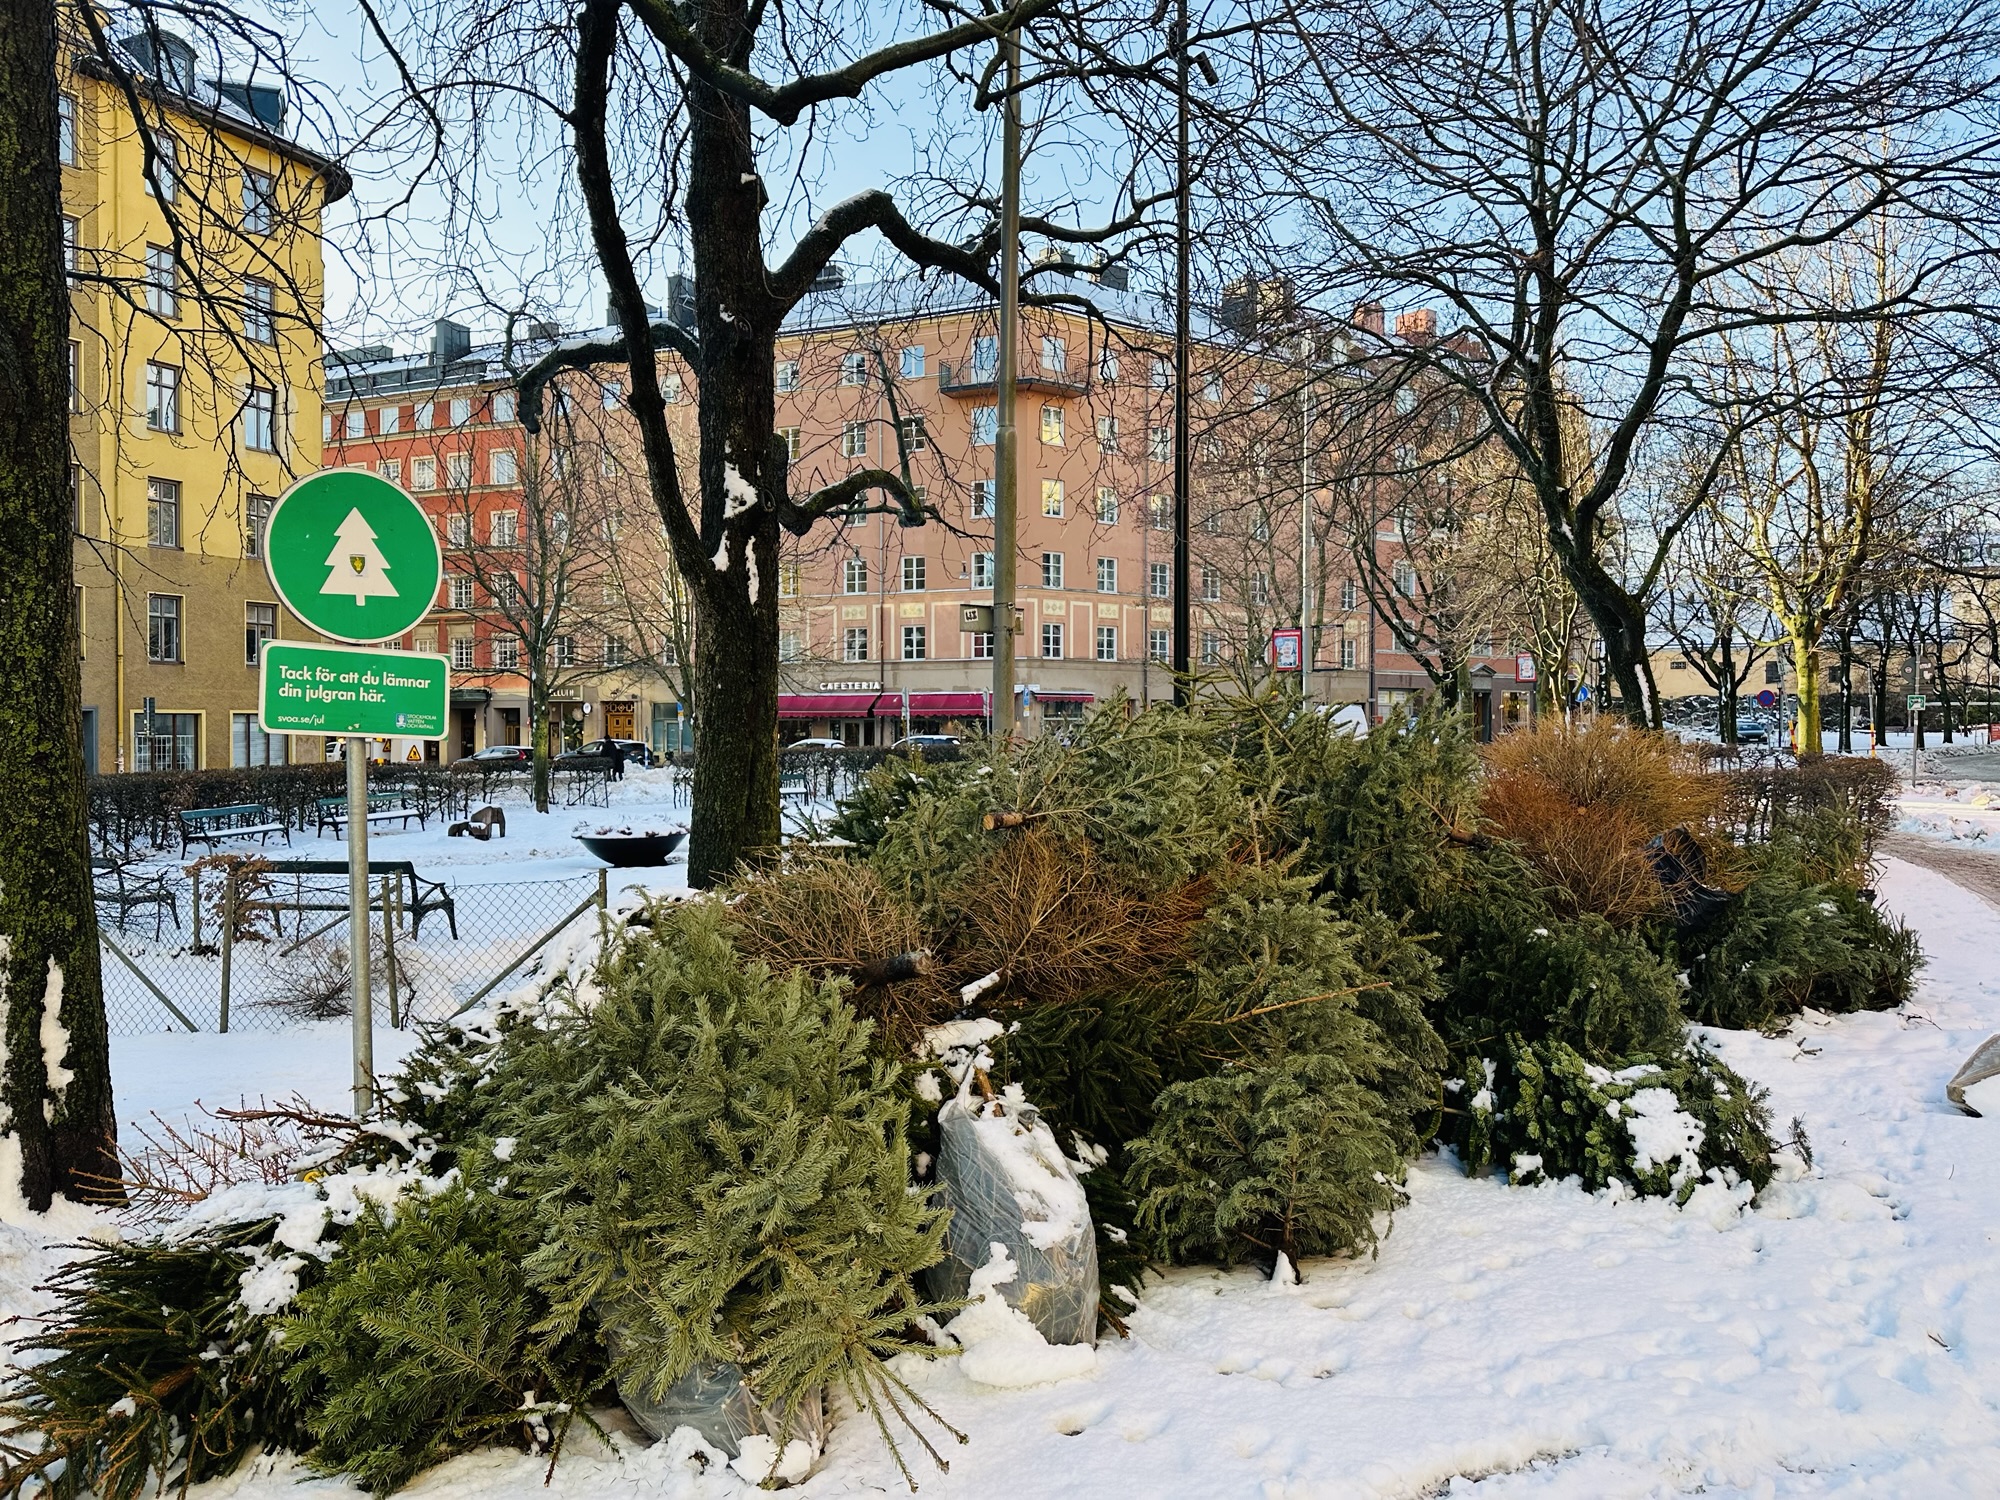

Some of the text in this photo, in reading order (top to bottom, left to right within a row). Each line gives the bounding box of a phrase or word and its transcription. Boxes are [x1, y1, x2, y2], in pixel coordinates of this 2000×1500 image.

[279, 665, 431, 688] Tack för att du lämnar
[278, 682, 386, 703] din julgran här.
[820, 681, 880, 690] CAFETERIA
[277, 714, 325, 726] svoa.se/jul
